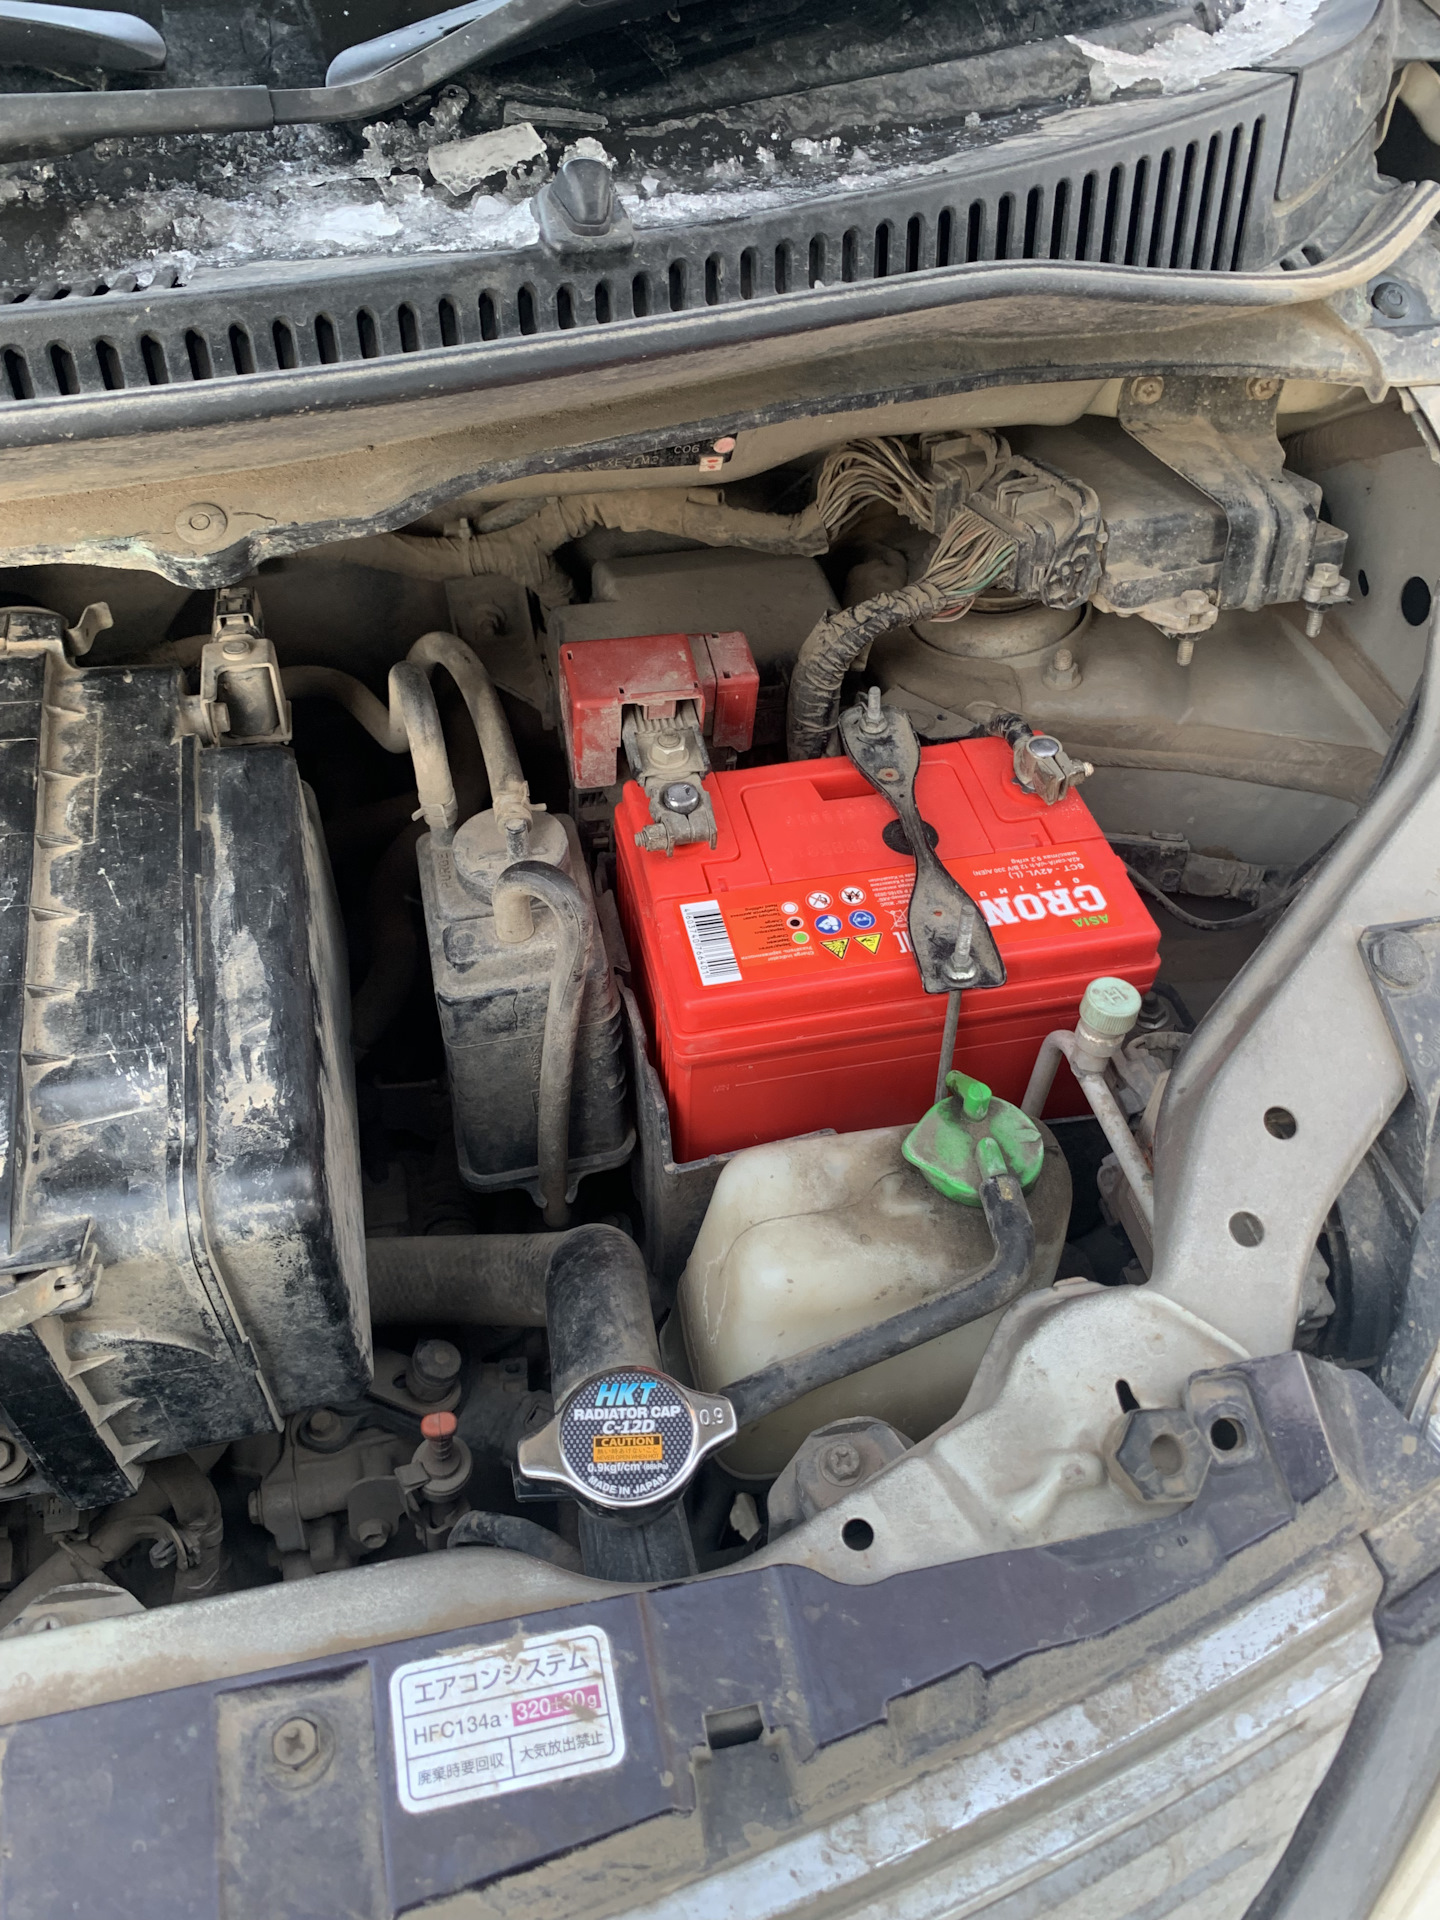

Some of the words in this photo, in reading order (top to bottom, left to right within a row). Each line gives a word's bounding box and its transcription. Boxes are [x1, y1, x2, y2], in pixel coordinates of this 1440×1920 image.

[1008, 870, 1023, 880] (L)
[1026, 866, 1053, 876] 42VL
[978, 876, 1080, 897] OPTIMU
[976, 884, 1108, 927] CRON
[1072, 914, 1109, 928] ASIA
[595, 1381, 658, 1406] HKT
[574, 1406, 648, 1421] RADIATOR
[651, 1405, 682, 1418] CAP
[699, 1406, 724, 1426] 0.9
[602, 1420, 656, 1434] C-12D
[600, 1436, 654, 1447] CAUTION
[588, 1475, 618, 1494] MADE
[618, 1486, 630, 1495] IN
[632, 1474, 667, 1494] JAPAN
[414, 1651, 590, 1704] エアコンシステム
[418, 1752, 505, 1786] 廃棄時要回収
[520, 1730, 605, 1762] 大気放出禁止
